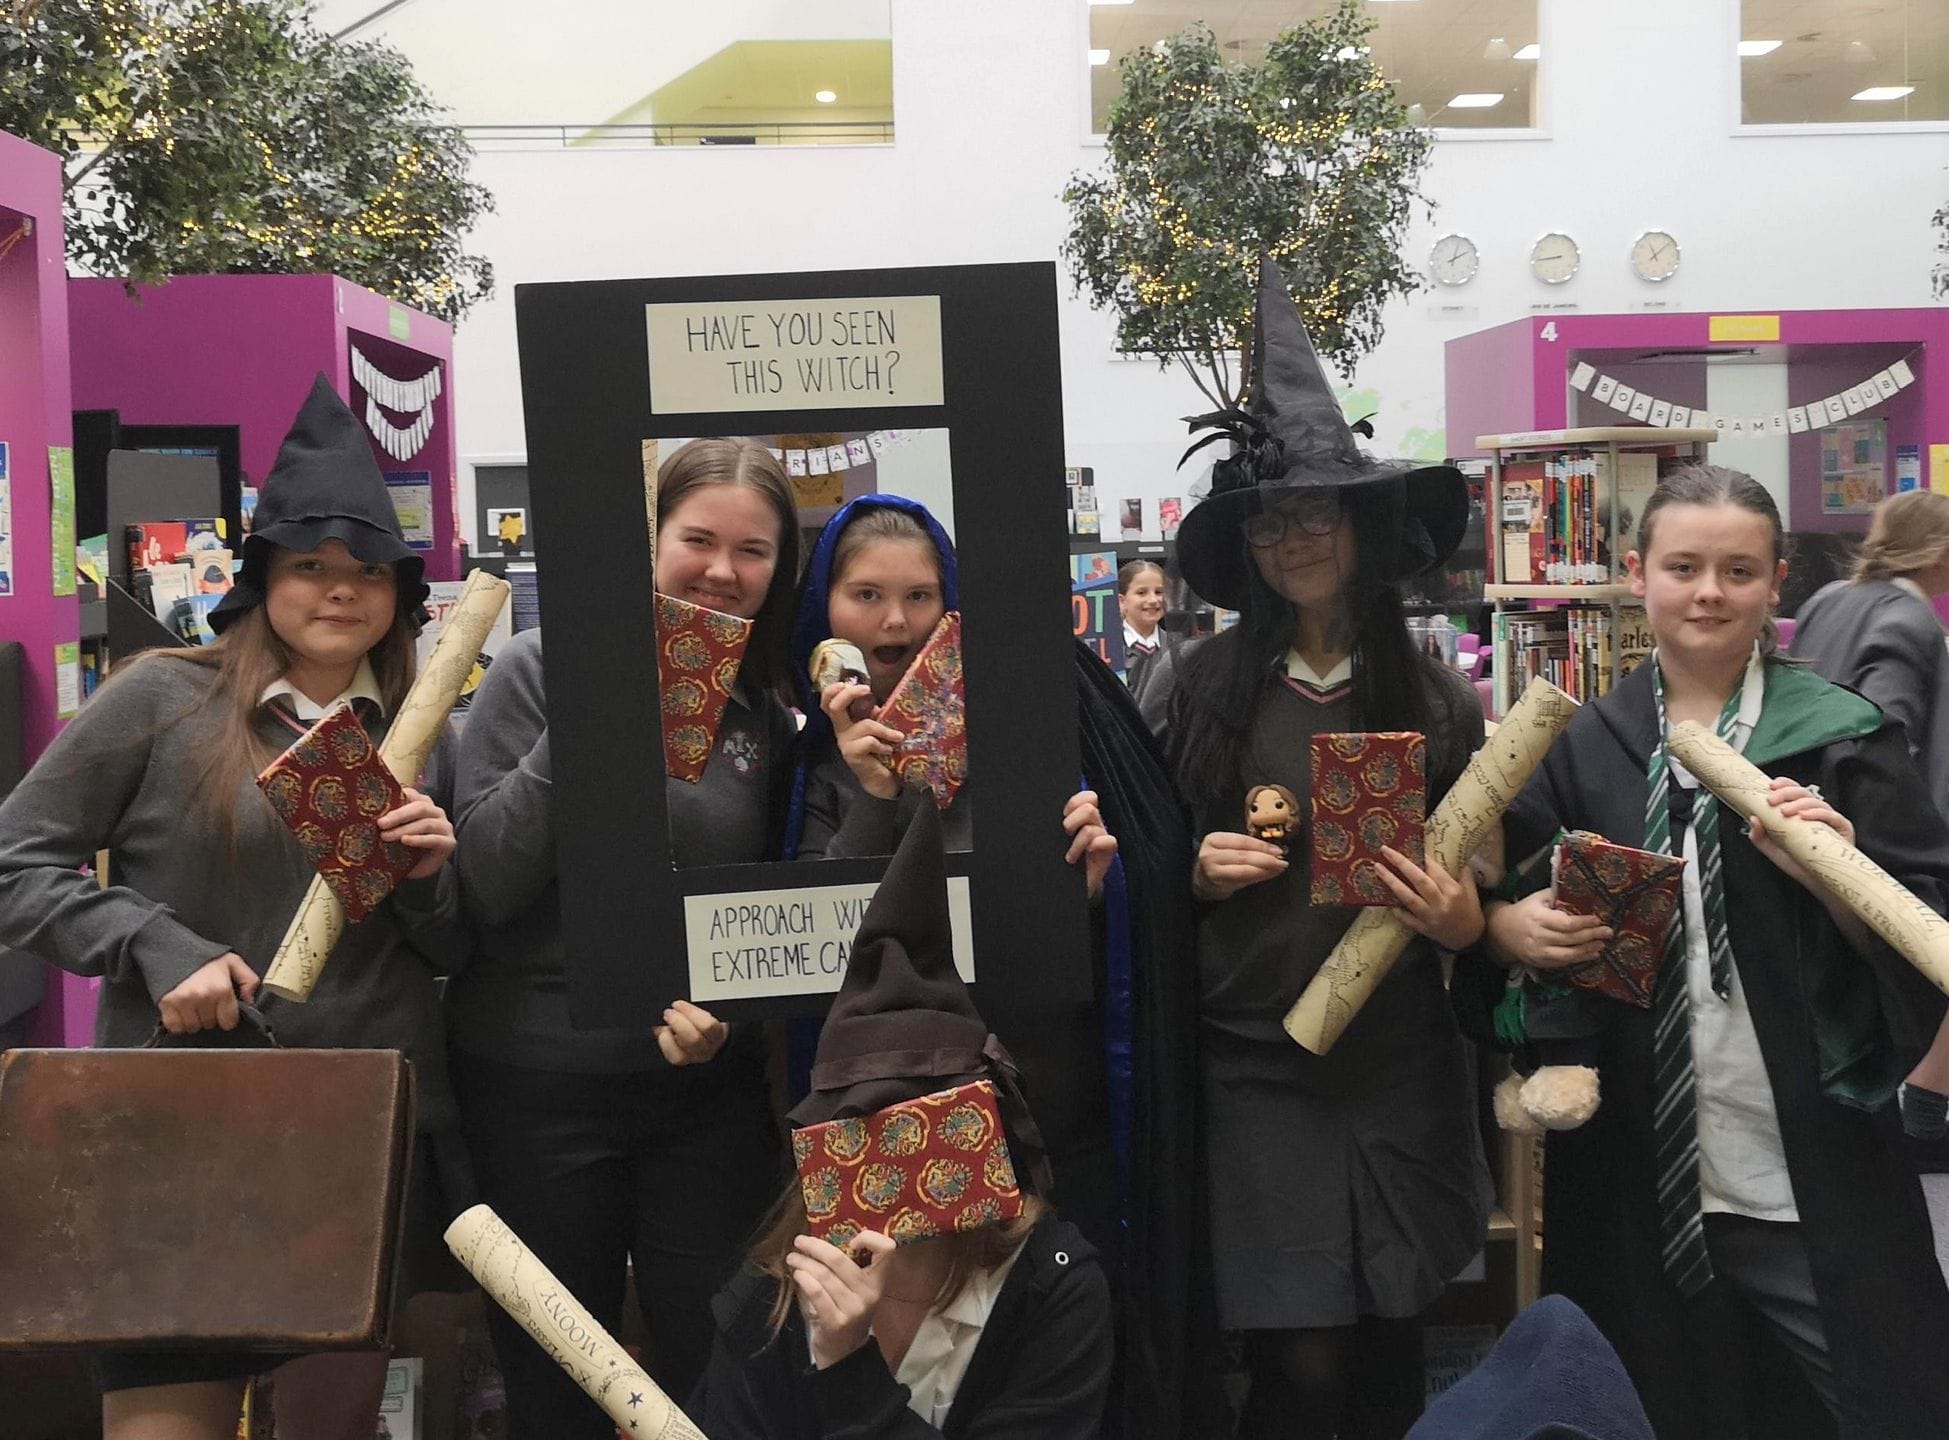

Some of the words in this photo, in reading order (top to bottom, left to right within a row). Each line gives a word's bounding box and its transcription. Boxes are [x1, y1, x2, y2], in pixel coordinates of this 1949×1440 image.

[687, 315, 760, 352] HAVE
[767, 312, 823, 347] YOU
[831, 309, 896, 346] SEEN
[1540, 321, 1559, 342] 4
[726, 359, 782, 394] THIS
[797, 350, 901, 395] WITCH?
[1601, 382, 1683, 421] BOARD
[1715, 414, 1801, 432] GAMES
[1831, 380, 1892, 412] CLUB
[792, 438, 882, 468] RIANS
[710, 902, 815, 940] APPROACH
[712, 942, 815, 983] EXTREME
[819, 940, 852, 975] CA
[540, 1286, 604, 1358] MOONY
